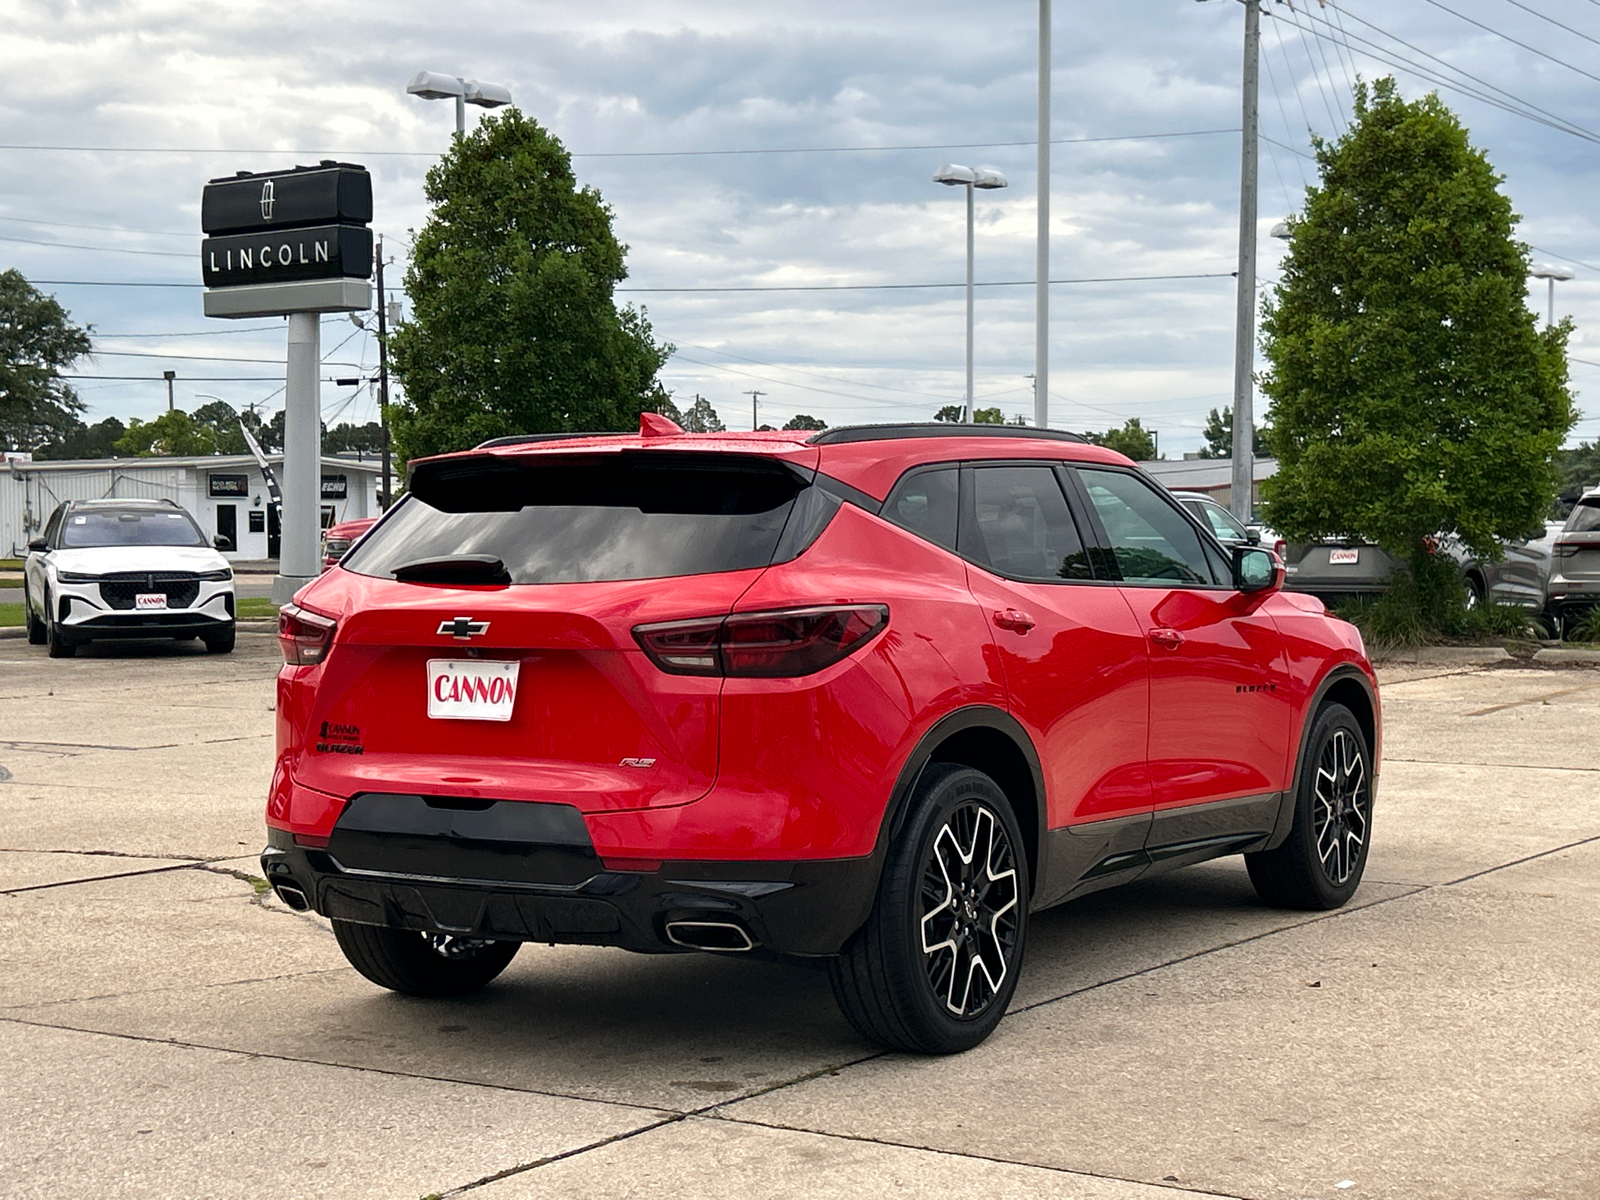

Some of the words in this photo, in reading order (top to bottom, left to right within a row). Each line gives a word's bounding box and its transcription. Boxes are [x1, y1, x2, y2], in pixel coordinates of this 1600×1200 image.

[210, 240, 329, 273] LINCOLN
[321, 482, 346, 492] ECHO
[1331, 552, 1356, 560] CANNON
[137, 597, 165, 605] CANNON
[434, 674, 517, 705] CANNON
[316, 742, 364, 755] BLAZER
[618, 757, 657, 768] RS
